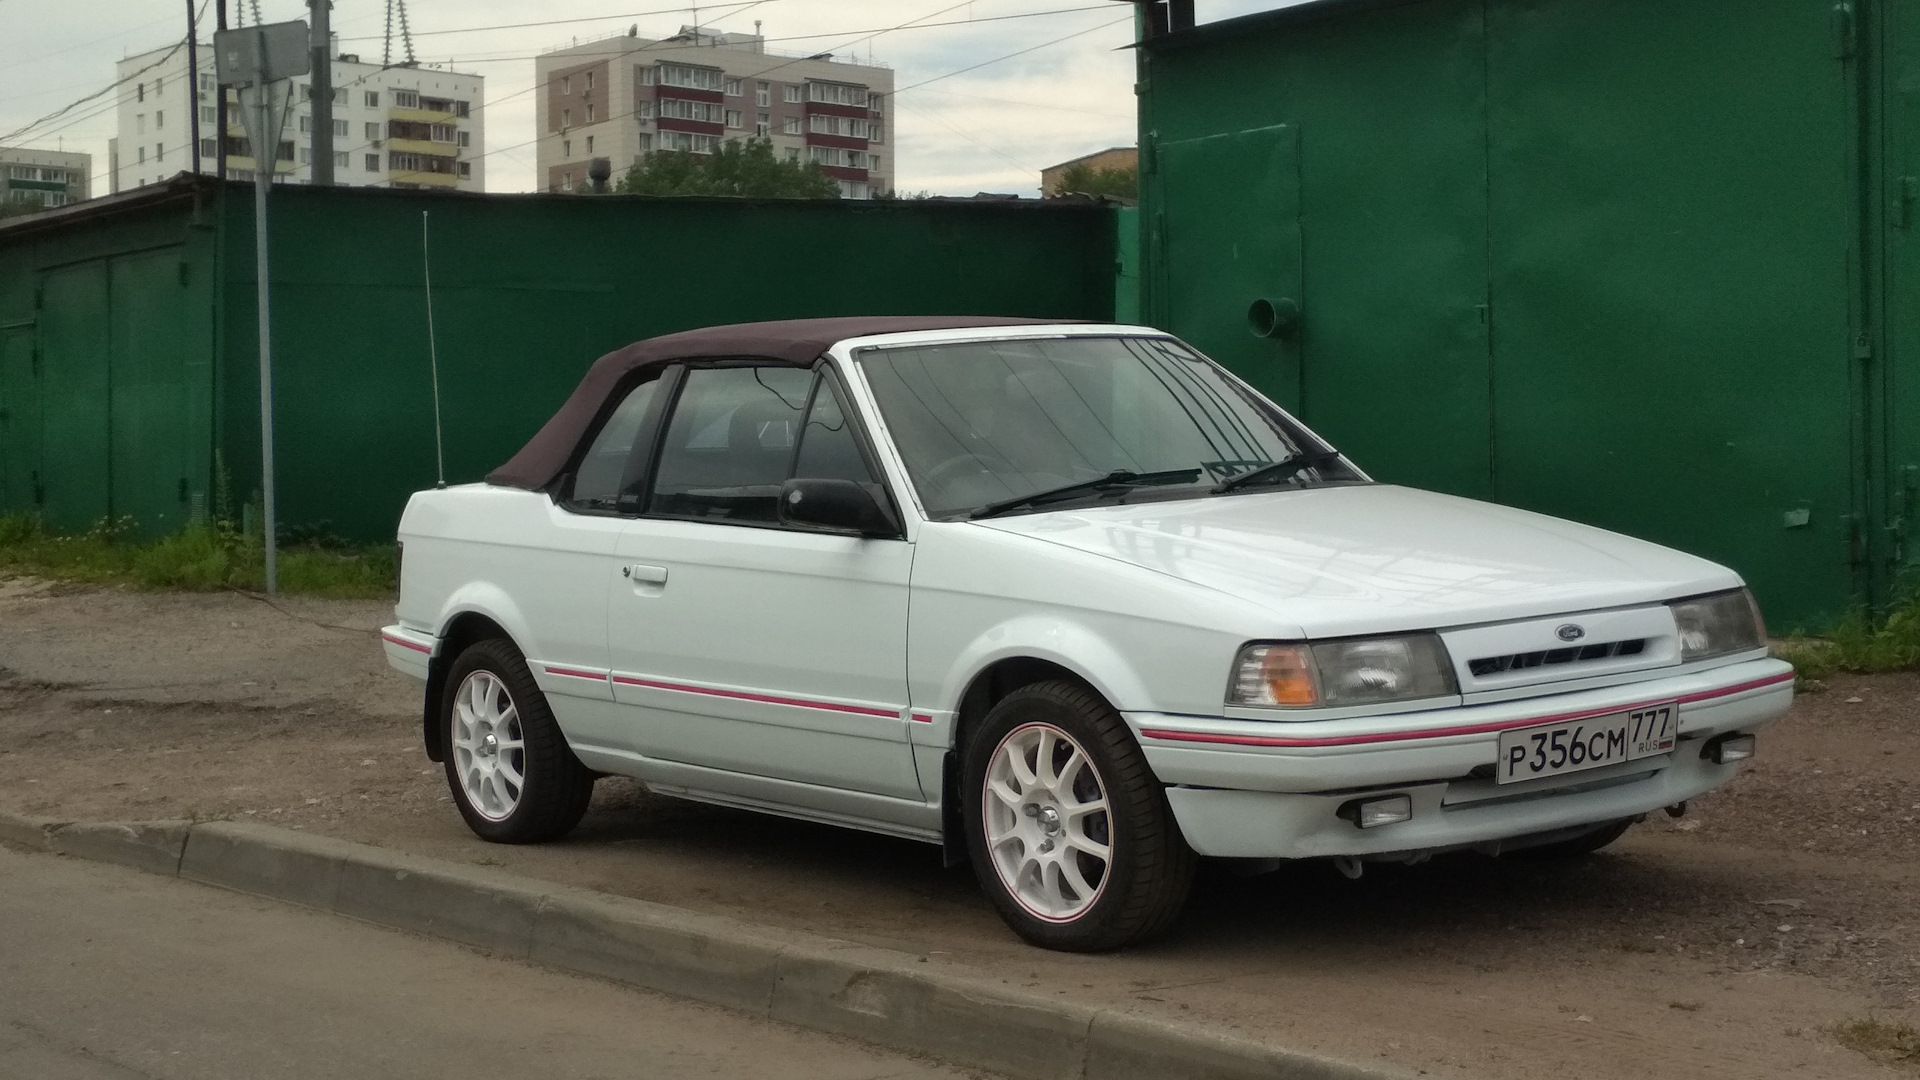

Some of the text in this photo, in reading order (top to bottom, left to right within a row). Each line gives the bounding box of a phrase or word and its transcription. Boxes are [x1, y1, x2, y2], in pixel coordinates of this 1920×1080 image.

[1509, 707, 1670, 776] P356CM 777
[1638, 740, 1658, 753] RUS
